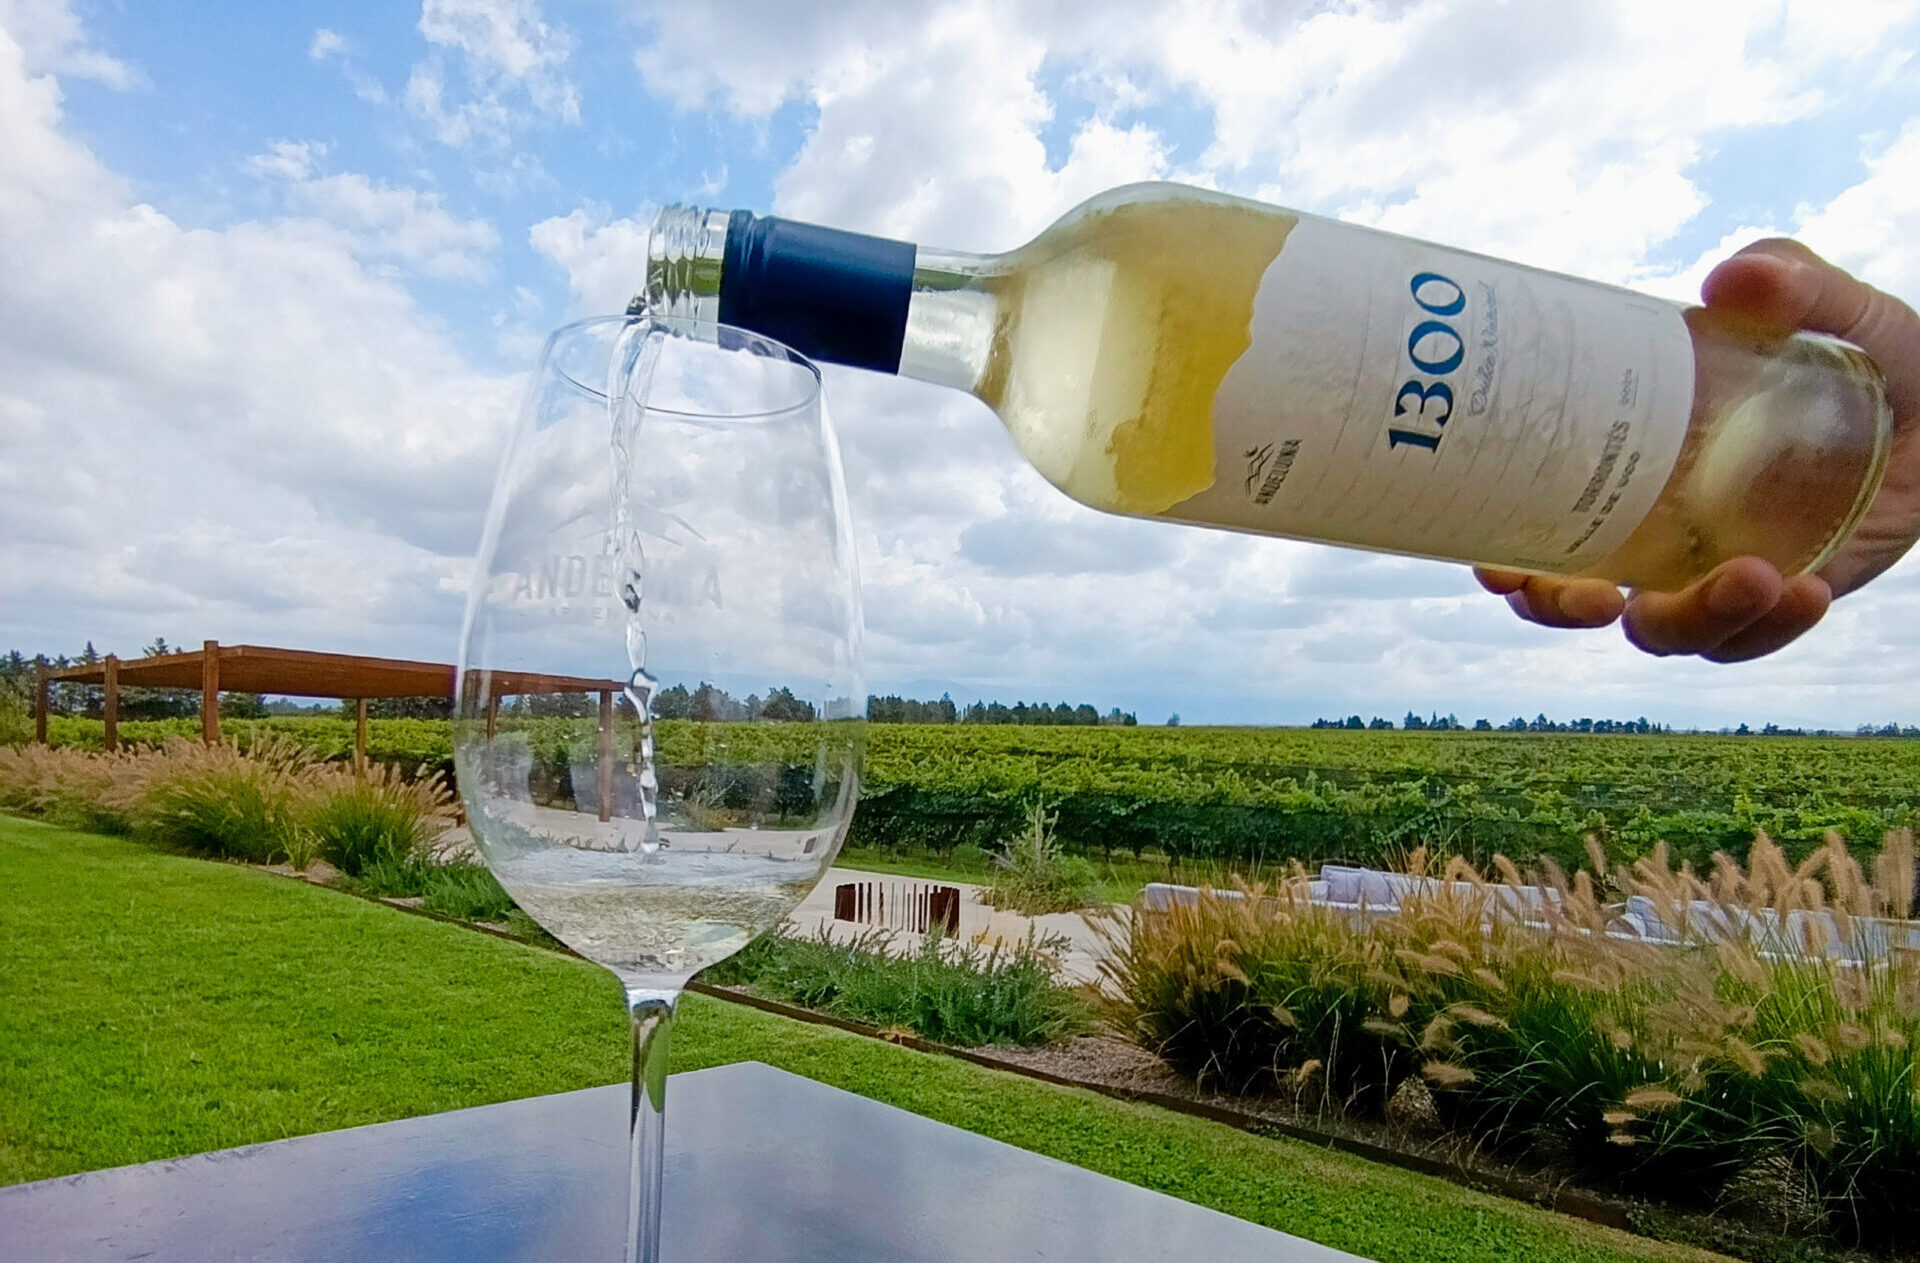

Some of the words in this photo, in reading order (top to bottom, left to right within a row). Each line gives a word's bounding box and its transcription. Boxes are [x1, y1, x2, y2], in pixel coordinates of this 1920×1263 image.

[1389, 272, 1466, 454] 1300
[1254, 439, 1304, 505] ANDELUNA
[1600, 491, 1622, 515] DE
[1616, 450, 1641, 488] UCO
